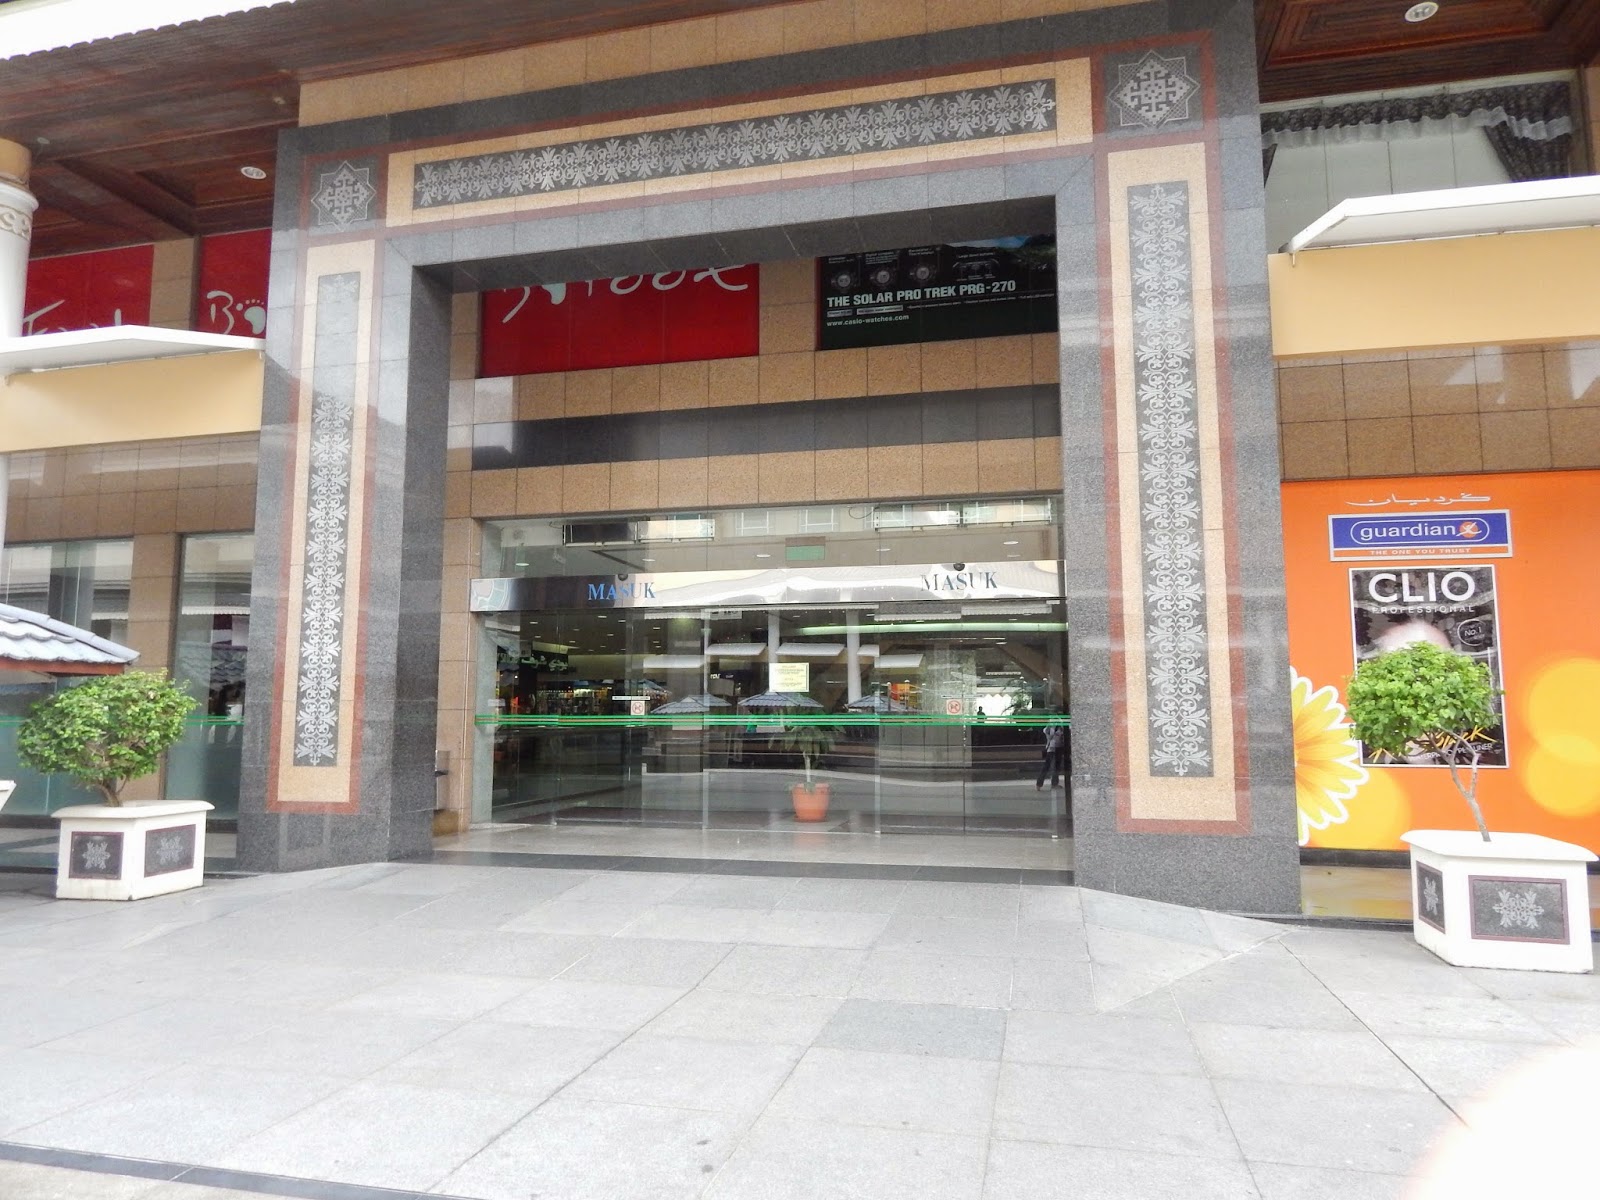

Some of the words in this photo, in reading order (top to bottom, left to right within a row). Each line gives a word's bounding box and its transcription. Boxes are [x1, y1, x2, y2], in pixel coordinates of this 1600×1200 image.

[827, 296, 850, 308] THE
[853, 292, 893, 306] SOLAR
[896, 289, 922, 301] PRO
[924, 285, 957, 299] TREK
[959, 280, 1016, 296] PRG-270
[826, 315, 910, 327] www.casio-watches.com
[1360, 523, 1456, 541] guardian
[920, 571, 998, 592] MASUK
[1368, 571, 1476, 603] CLIO
[587, 582, 656, 601] MASUK
[1371, 605, 1476, 615] PROFESSIONAL
